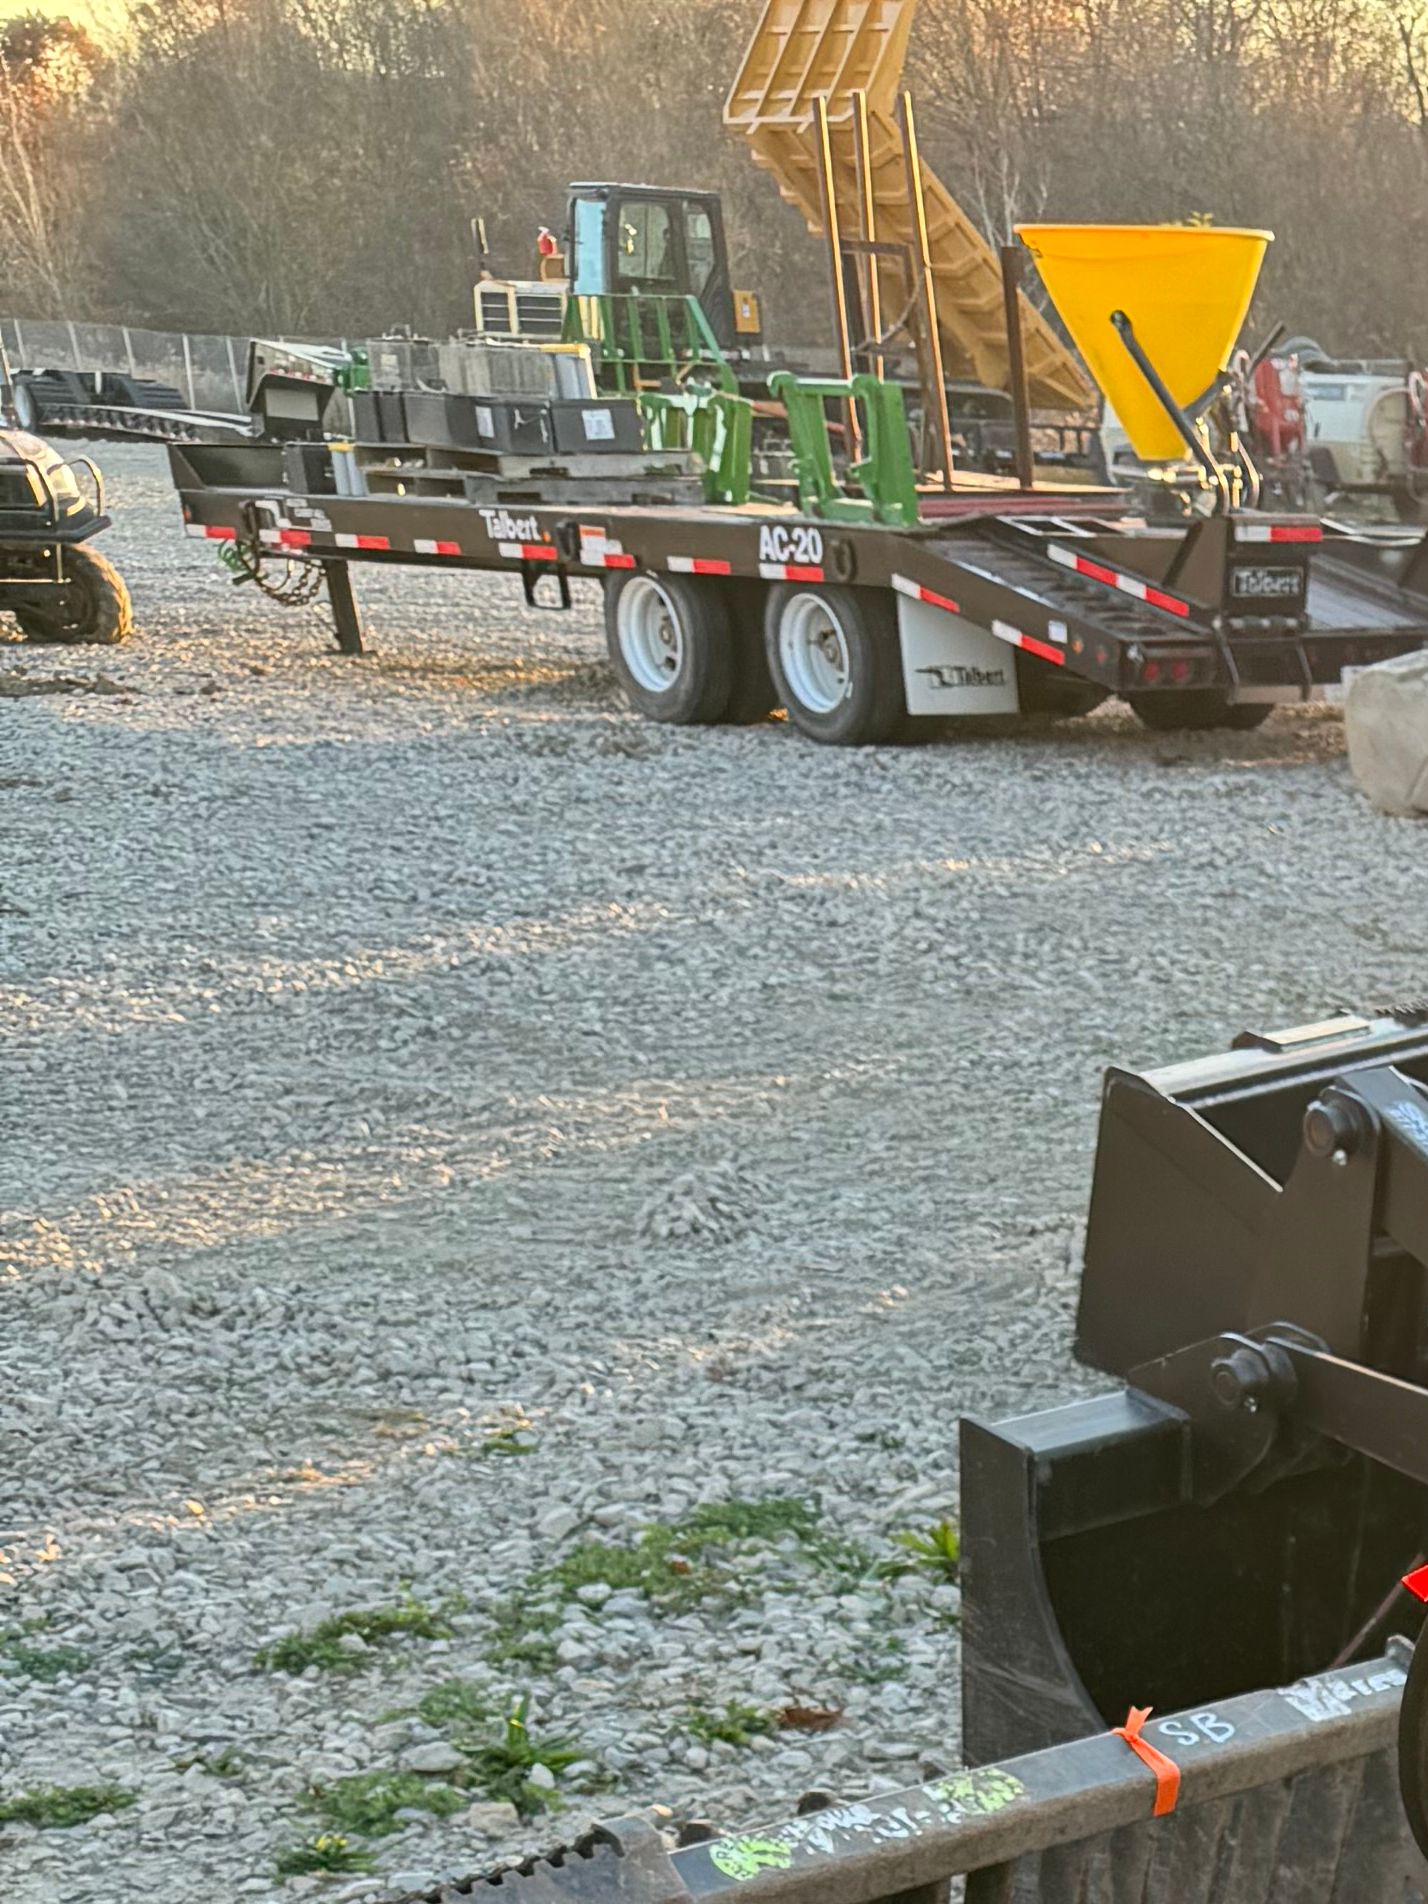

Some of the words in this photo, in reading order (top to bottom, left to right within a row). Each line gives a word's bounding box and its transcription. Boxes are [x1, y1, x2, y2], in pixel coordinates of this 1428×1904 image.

[478, 509, 541, 541] Talbert
[759, 525, 823, 564] AC-20
[1158, 1711, 1235, 1746] SB
